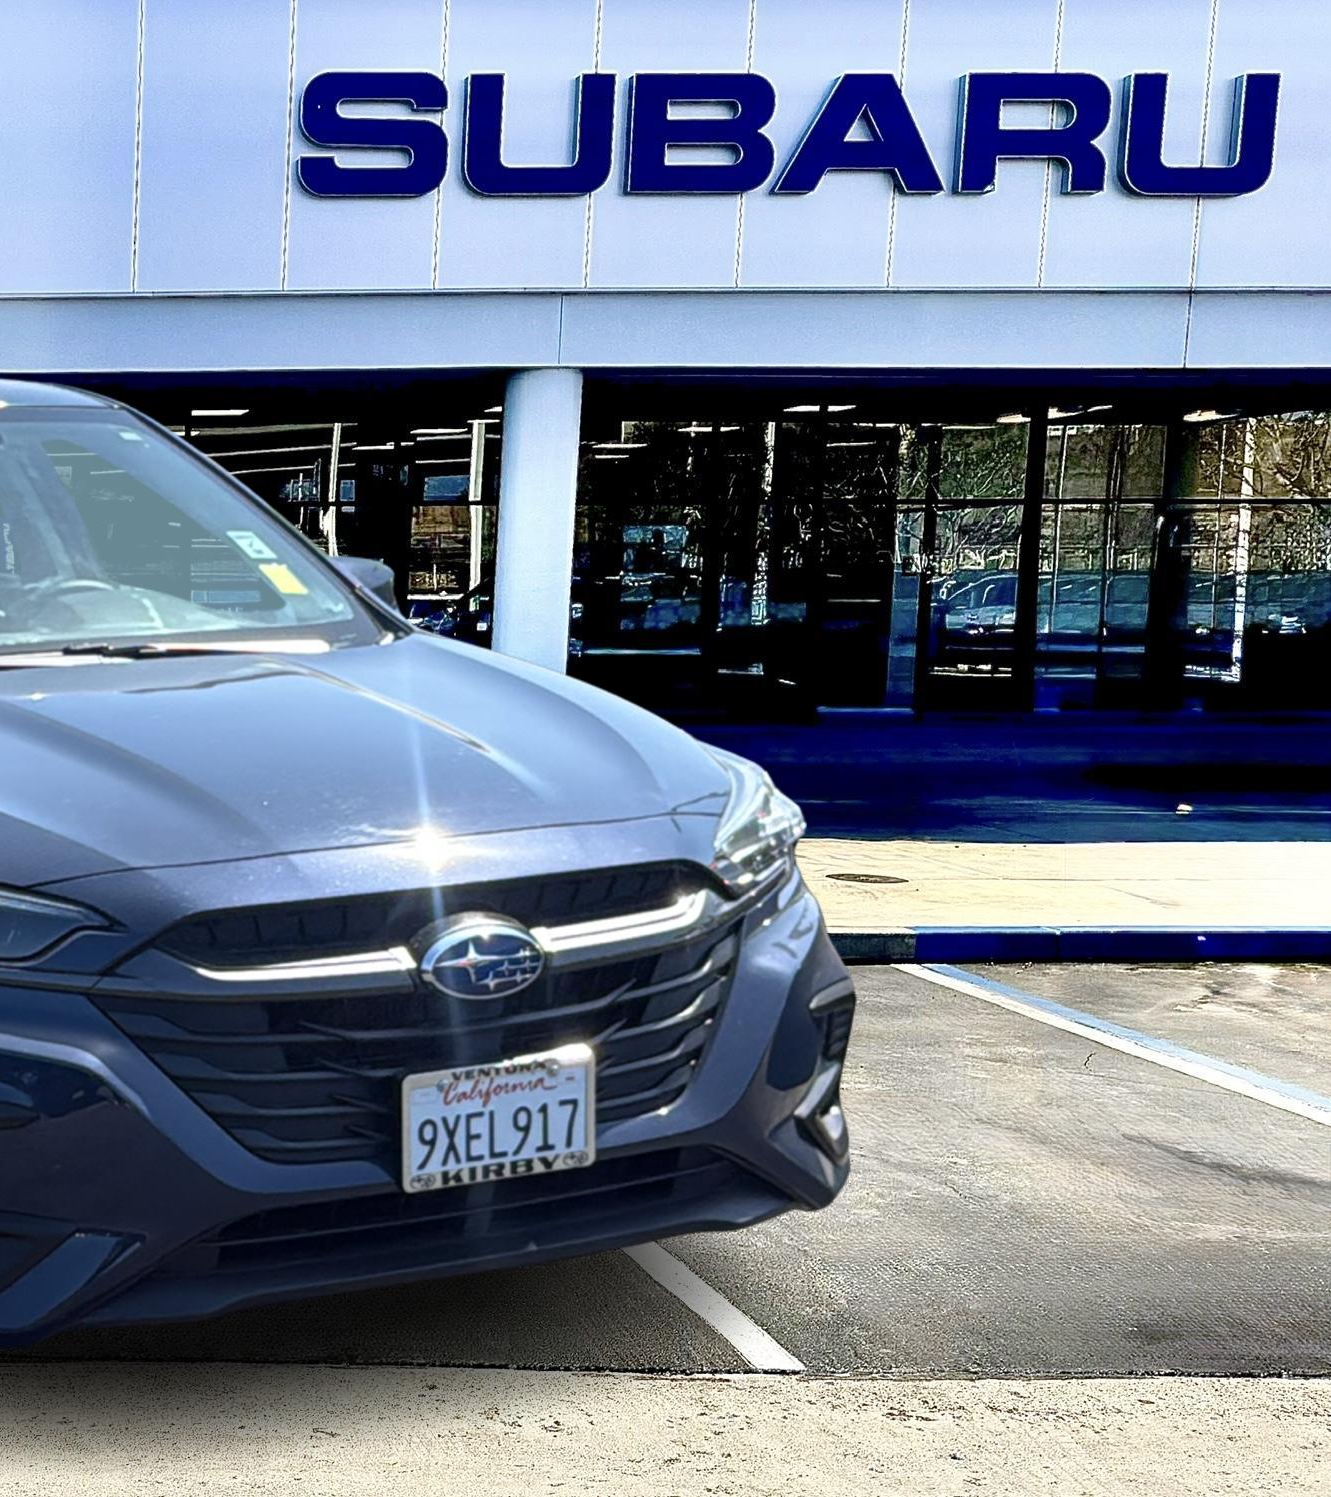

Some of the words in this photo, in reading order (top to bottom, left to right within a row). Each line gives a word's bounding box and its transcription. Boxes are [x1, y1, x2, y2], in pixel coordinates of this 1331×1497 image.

[297, 72, 1280, 197] SUBARU
[443, 1076, 557, 1107] California
[417, 1098, 579, 1171] 9XEL917
[441, 1153, 560, 1186] KIRBY
